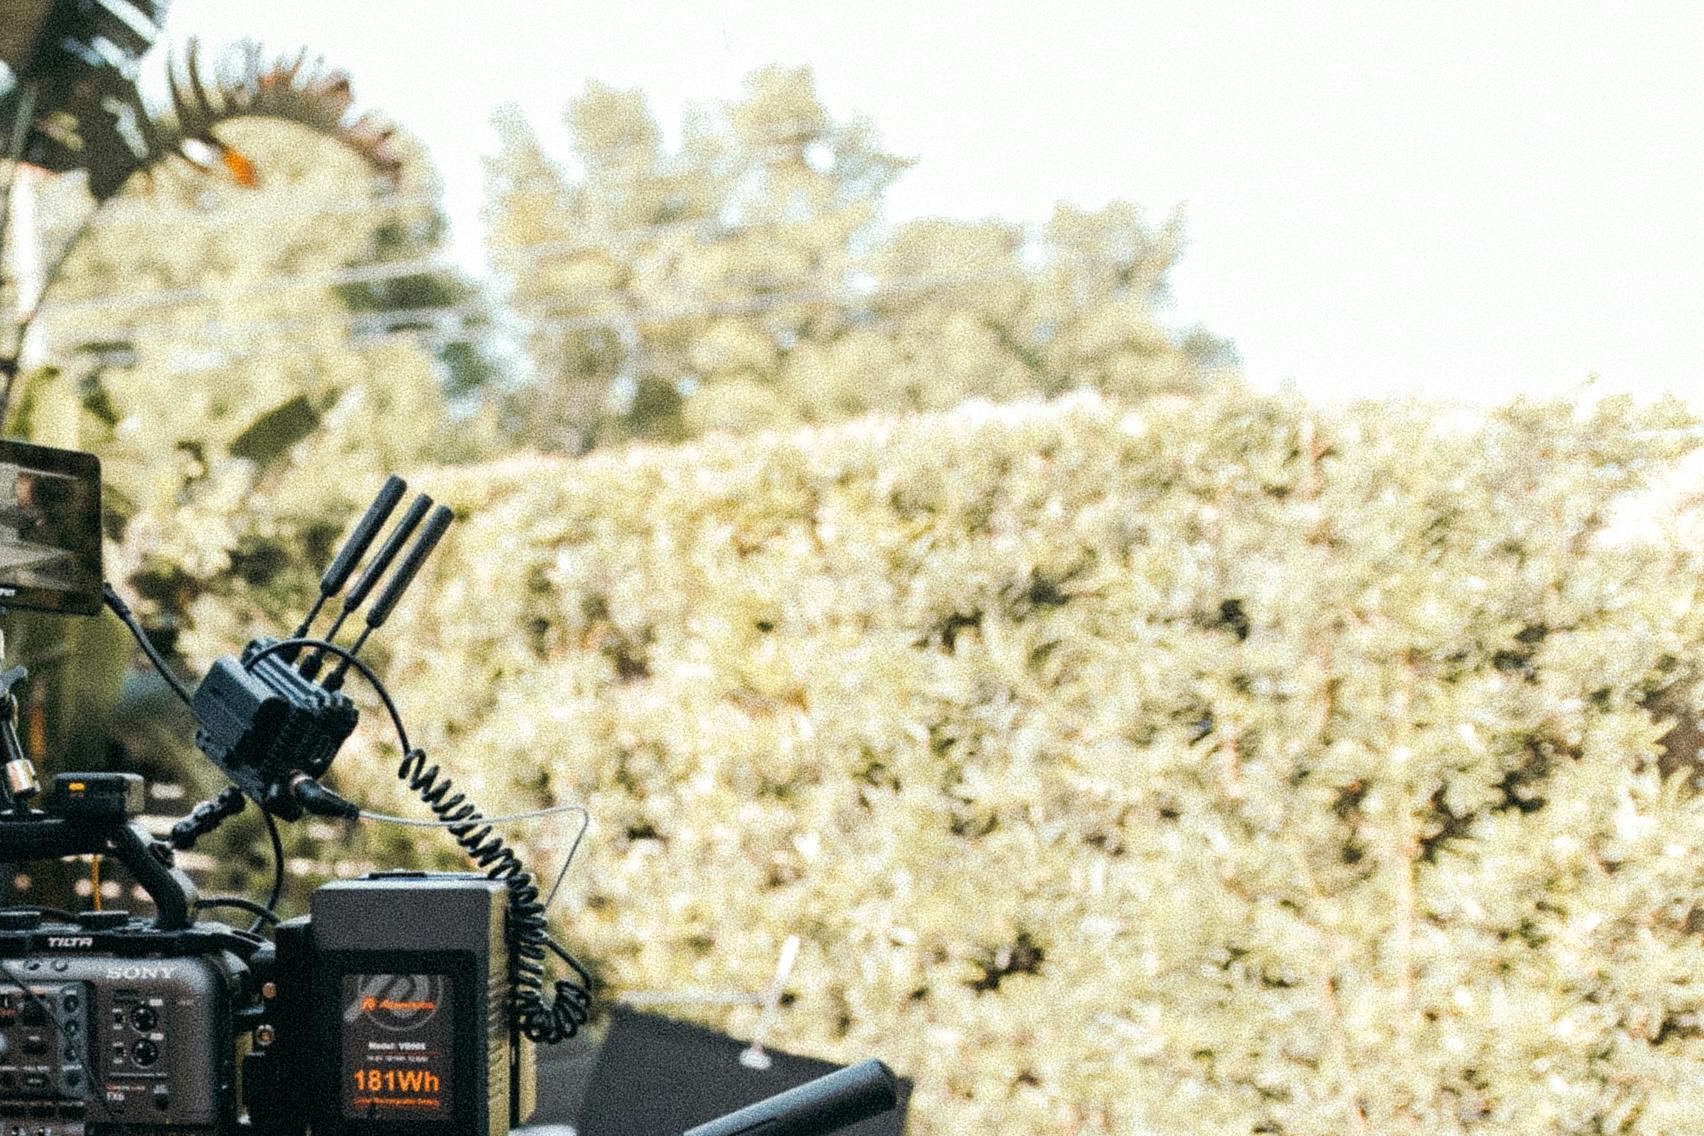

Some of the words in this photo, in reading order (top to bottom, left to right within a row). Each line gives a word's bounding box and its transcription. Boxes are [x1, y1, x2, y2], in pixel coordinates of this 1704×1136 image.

[48, 936, 93, 948] TILTA
[106, 966, 177, 980] SONY
[354, 1068, 440, 1093] 181Wh
